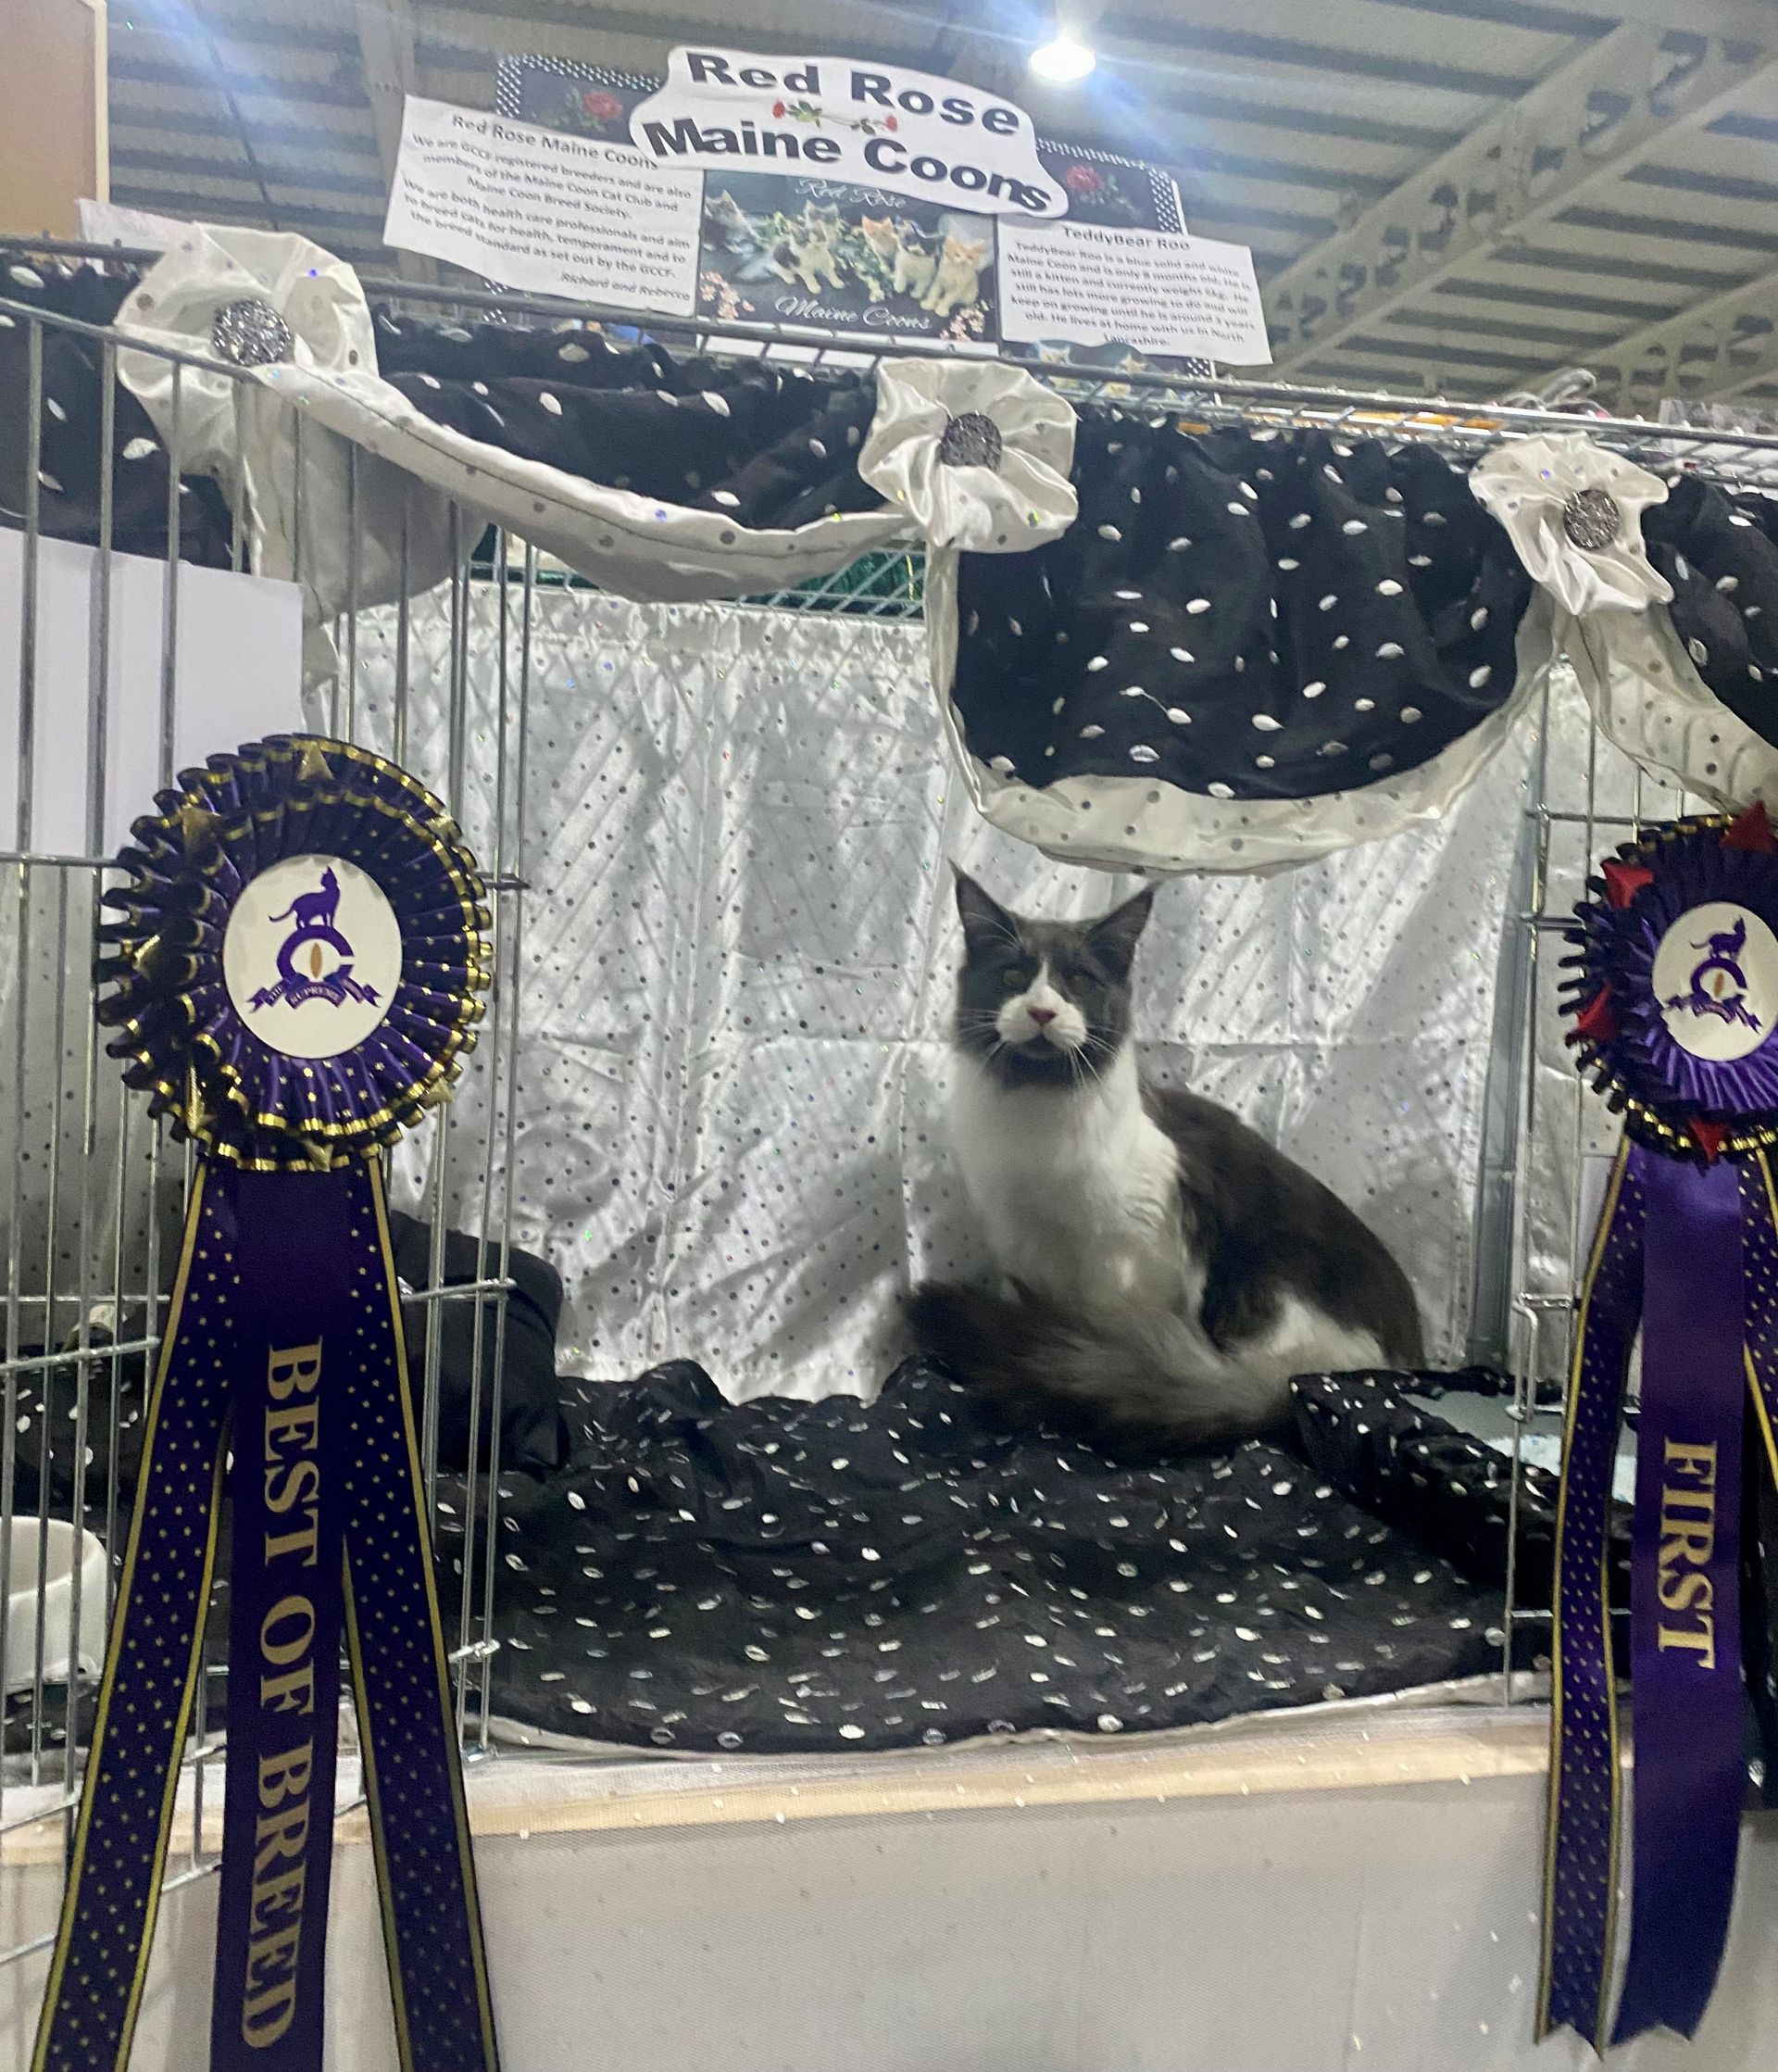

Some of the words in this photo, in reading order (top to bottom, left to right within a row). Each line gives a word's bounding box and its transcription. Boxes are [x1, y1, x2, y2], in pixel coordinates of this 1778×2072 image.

[686, 51, 821, 95] Red
[851, 69, 1020, 136] Rose
[452, 113, 487, 135] Red
[493, 124, 536, 146] Rose
[542, 135, 599, 159] Maine
[412, 129, 434, 148] We
[437, 140, 458, 149] are
[461, 142, 493, 160] GCCF
[495, 154, 557, 173] registered
[560, 164, 615, 184] breeders
[618, 177, 641, 190] and
[644, 184, 664, 195] are
[667, 186, 692, 199] also
[422, 153, 482, 174] members
[484, 169, 498, 179] of
[500, 170, 521, 182] the
[524, 173, 564, 190] Maine
[567, 182, 599, 196] Coon
[602, 189, 622, 202] Cat
[625, 193, 652, 207] Club
[654, 200, 679, 212] and
[641, 118, 842, 164] Maine
[863, 137, 1052, 211] Coons
[400, 170, 425, 194] We
[427, 189, 448, 200] are
[451, 190, 481, 210] both
[482, 203, 523, 220] health
[526, 213, 554, 226] care
[556, 217, 638, 241] professionals
[641, 232, 664, 245] and
[667, 236, 690, 249] aim
[467, 175, 506, 195] Maine
[508, 187, 542, 202] Coon
[544, 193, 581, 209] Breed
[584, 202, 632, 220] Society.
[404, 192, 418, 206] to
[420, 199, 458, 218] breed
[460, 211, 485, 229] cats
[488, 221, 507, 234] for
[556, 233, 643, 258] temperament
[645, 248, 670, 262] and
[672, 253, 686, 264] to
[410, 209, 432, 226] the
[434, 219, 472, 237] breed
[474, 232, 531, 255] standard
[532, 247, 546, 257] as
[550, 250, 570, 262] set
[572, 253, 595, 266] out
[596, 256, 612, 270] by
[616, 259, 637, 273] the
[1061, 224, 1152, 247] TeddyBear
[1158, 238, 1191, 251] Roo
[1008, 253, 1045, 267] Maine
[1046, 259, 1077, 270] Coon
[1079, 264, 1100, 274] and
[1103, 266, 1112, 275] is
[1115, 267, 1140, 280] only
[1153, 271, 1197, 282] months
[1016, 241, 1076, 257] TeddyBear
[1079, 250, 1102, 260] Roo
[1104, 253, 1114, 263] is
[1126, 256, 1151, 268] blue
[1184, 261, 1206, 270] and
[561, 271, 610, 289] Richard
[612, 280, 636, 293] and
[639, 284, 690, 302] Rebecca
[1011, 269, 1033, 279] still
[1035, 271, 1043, 280] a
[1045, 270, 1079, 284] kitten
[1082, 278, 1104, 288] and
[1107, 280, 1158, 295] currently
[1162, 285, 1203, 296] weighs
[1016, 283, 1036, 294] still
[1039, 284, 1060, 295] has
[1062, 286, 1083, 298] lots
[1086, 292, 1118, 303] more
[1120, 295, 1168, 308] growing
[1171, 299, 1183, 308] to
[1185, 300, 1201, 309] do
[1204, 303, 1225, 312] and
[1227, 305, 1249, 316] will
[774, 295, 859, 322] Maine
[862, 305, 933, 330] Coons
[1010, 294, 1040, 308] keep
[1043, 299, 1058, 309] on
[1060, 302, 1108, 316] growing
[1111, 307, 1137, 318] until
[1140, 308, 1156, 320] he
[1158, 311, 1168, 320] is
[1171, 313, 1213, 323] around
[1224, 319, 1256, 331] years
[1051, 312, 1068, 323] He
[1070, 313, 1096, 327] lives
[1099, 319, 1111, 329] at
[1114, 320, 1148, 332] home
[1151, 323, 1178, 334] with
[1181, 325, 1195, 334] us
[1197, 326, 1209, 336] in
[1211, 328, 1245, 343] North
[265, 1335, 323, 1567] BEST
[1659, 1437, 1717, 1669] FIRST
[260, 1595, 316, 1714] OF
[243, 1735, 314, 2049] BREED
